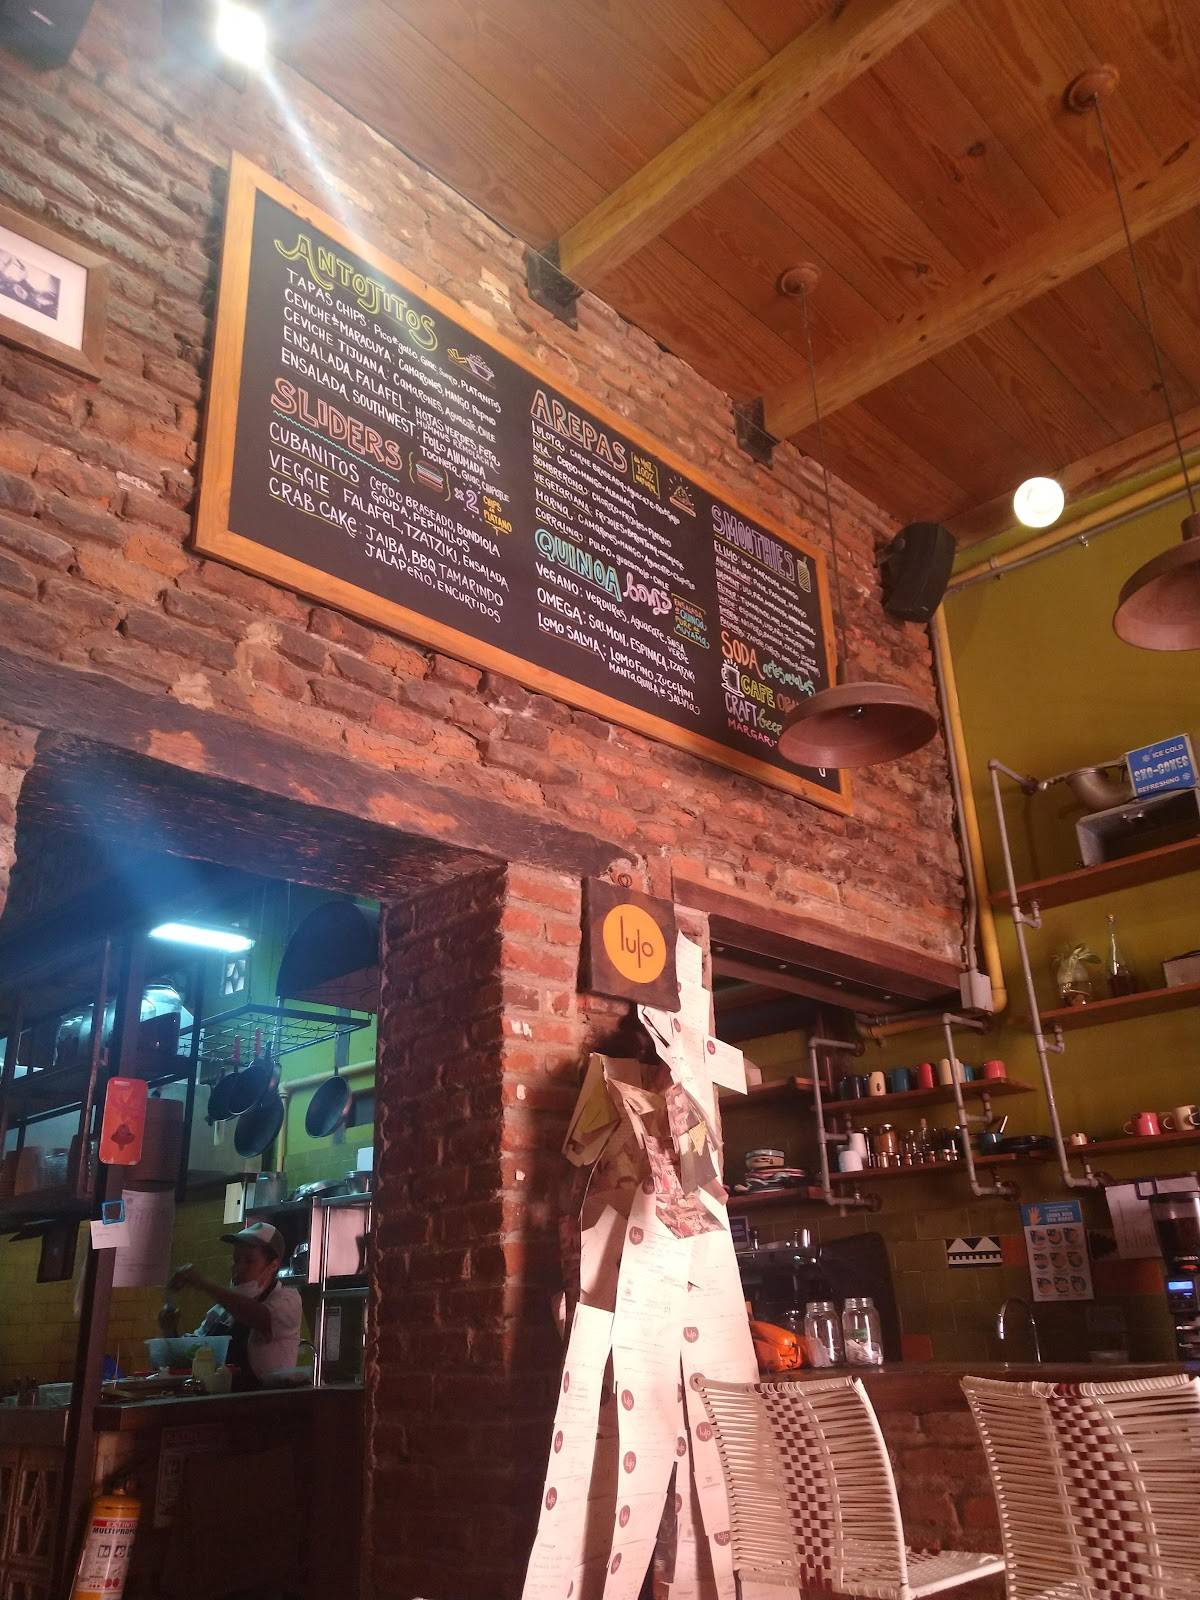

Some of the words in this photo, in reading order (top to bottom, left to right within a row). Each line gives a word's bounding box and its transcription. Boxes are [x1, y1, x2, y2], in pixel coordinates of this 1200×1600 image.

[274, 233, 438, 351] ANTOJITOS
[284, 288, 332, 326] CEVICHE
[286, 267, 333, 306] TAPAS
[283, 306, 334, 346] CEVICHE
[283, 325, 354, 382] ENSALADA
[281, 346, 350, 402] ENSALADA
[271, 377, 403, 471] SLIDERS
[530, 389, 628, 473] AREPAS
[268, 476, 316, 512] CRAB
[411, 549, 437, 577] BBQ
[438, 562, 504, 607] TAMARINDO
[535, 528, 623, 602] QUINOA
[711, 504, 795, 582] SMOOTHIES
[437, 580, 501, 624] ENCURTIDOS
[720, 630, 766, 680] SODA
[724, 691, 757, 728] CRAFT
[619, 915, 654, 969] lulo
